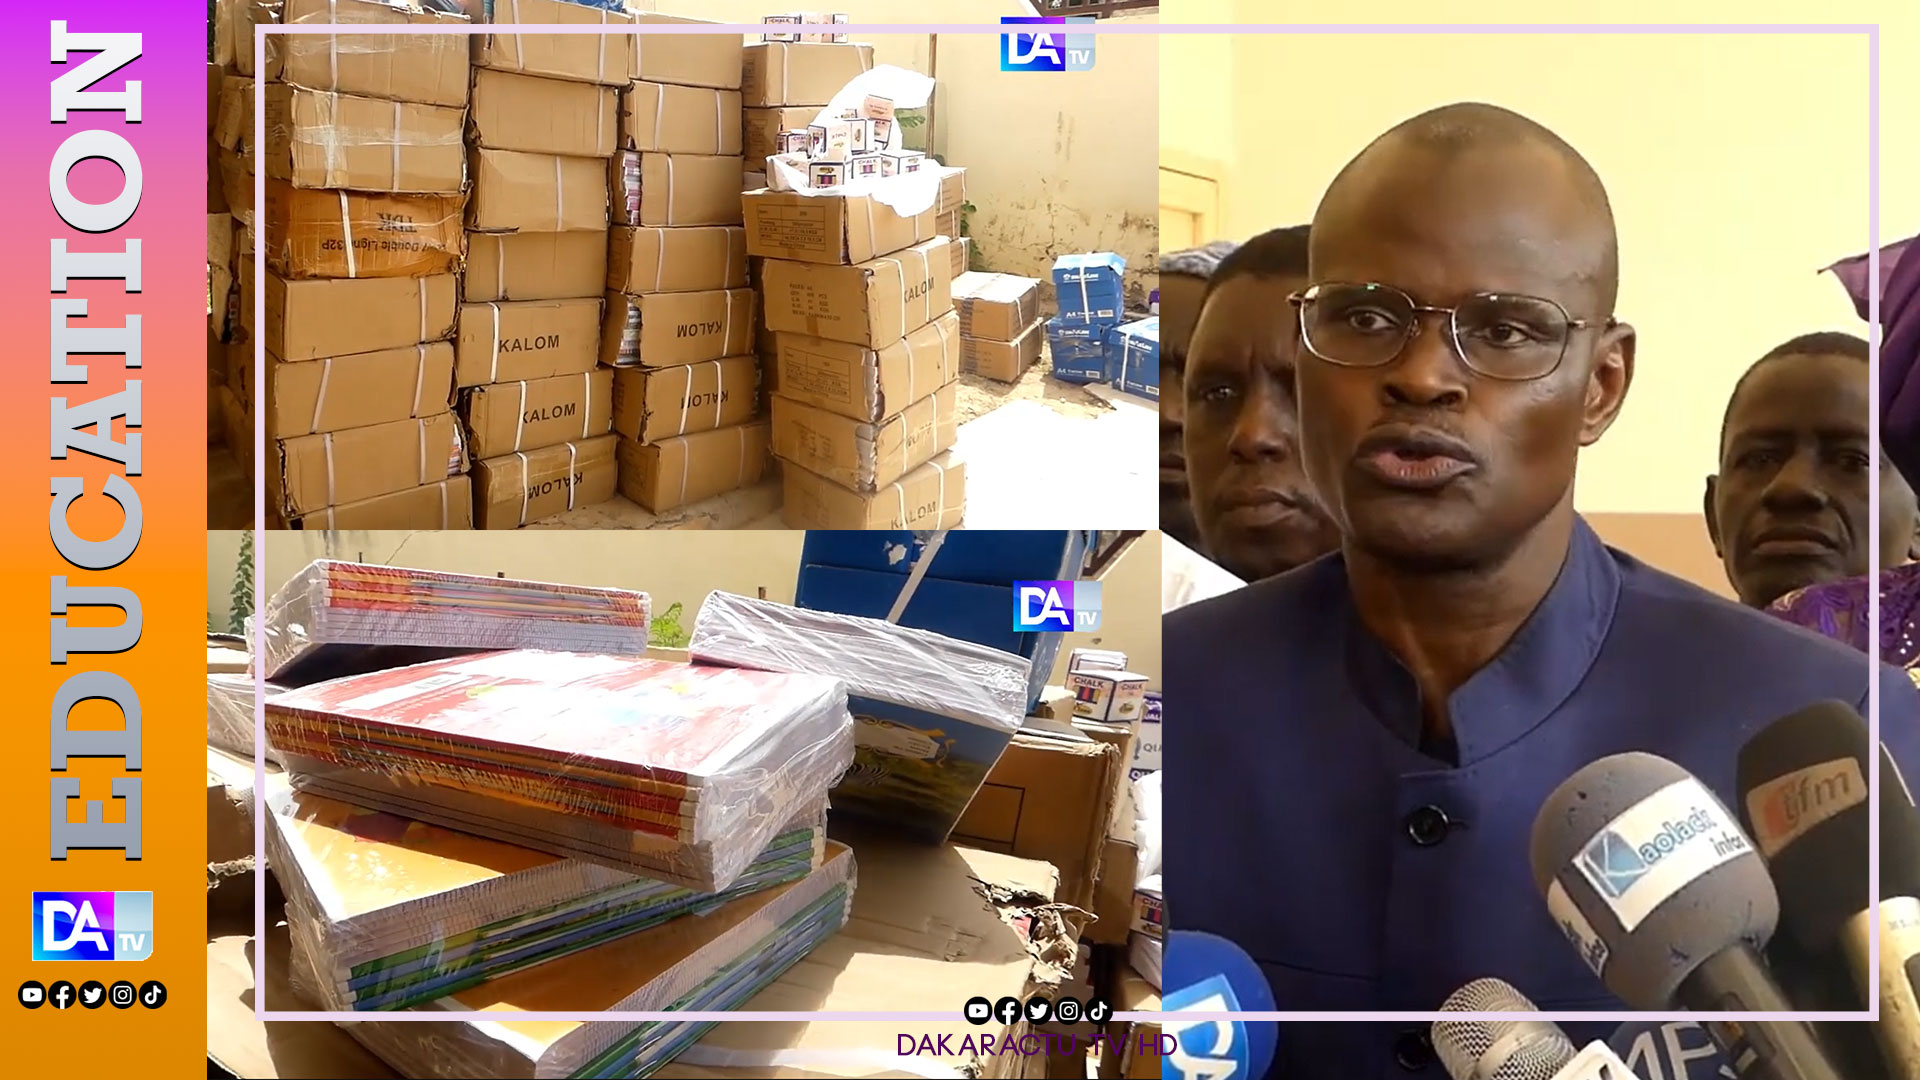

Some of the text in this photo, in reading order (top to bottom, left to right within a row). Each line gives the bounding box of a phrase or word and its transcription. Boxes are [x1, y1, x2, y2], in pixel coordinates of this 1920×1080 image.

[347, 239, 378, 252] Lign
[676, 321, 723, 338] KALOM
[499, 335, 560, 353] KALOM
[1074, 677, 1105, 689] CHALK
[1121, 683, 1143, 691] CHALK
